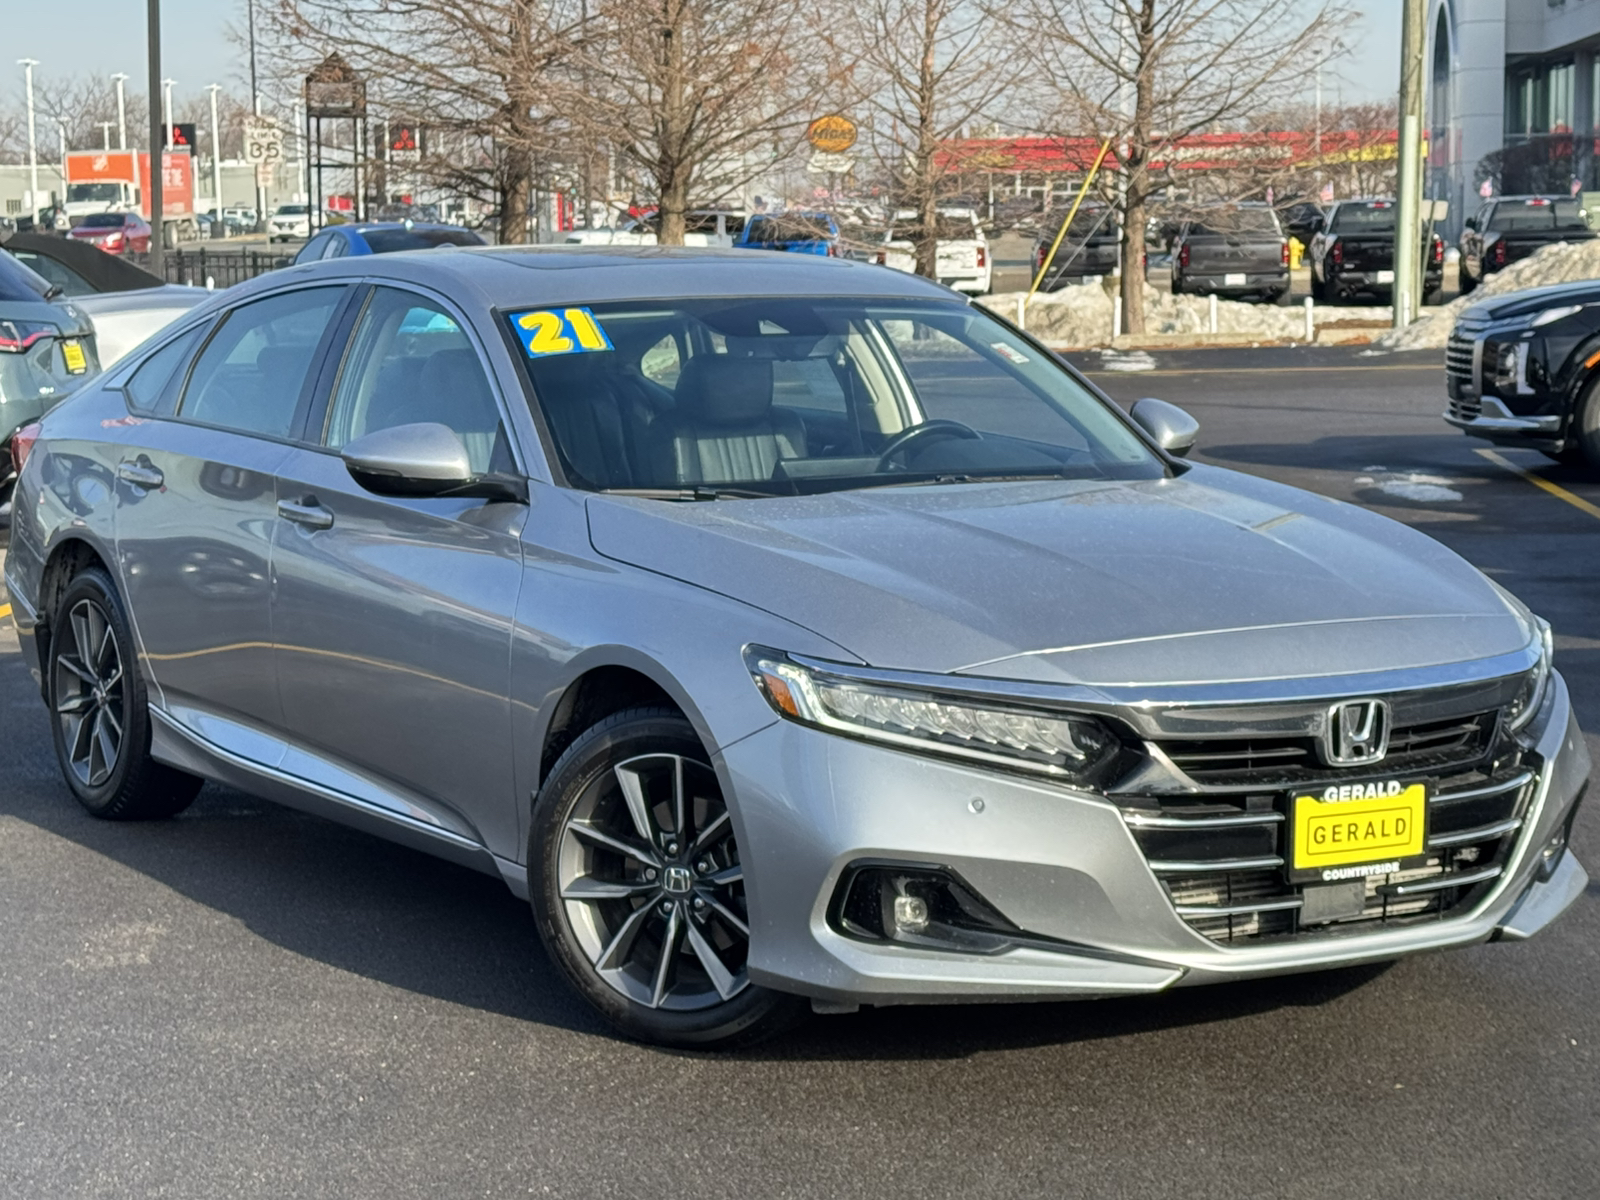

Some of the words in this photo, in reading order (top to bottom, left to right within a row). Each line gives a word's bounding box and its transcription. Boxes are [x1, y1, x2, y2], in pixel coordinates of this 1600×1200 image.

[250, 141, 279, 158] 35
[519, 308, 607, 353] 21
[1323, 780, 1402, 803] GERALD
[1313, 817, 1407, 845] GERALD
[1322, 861, 1401, 881] COUNTRYSIDE
